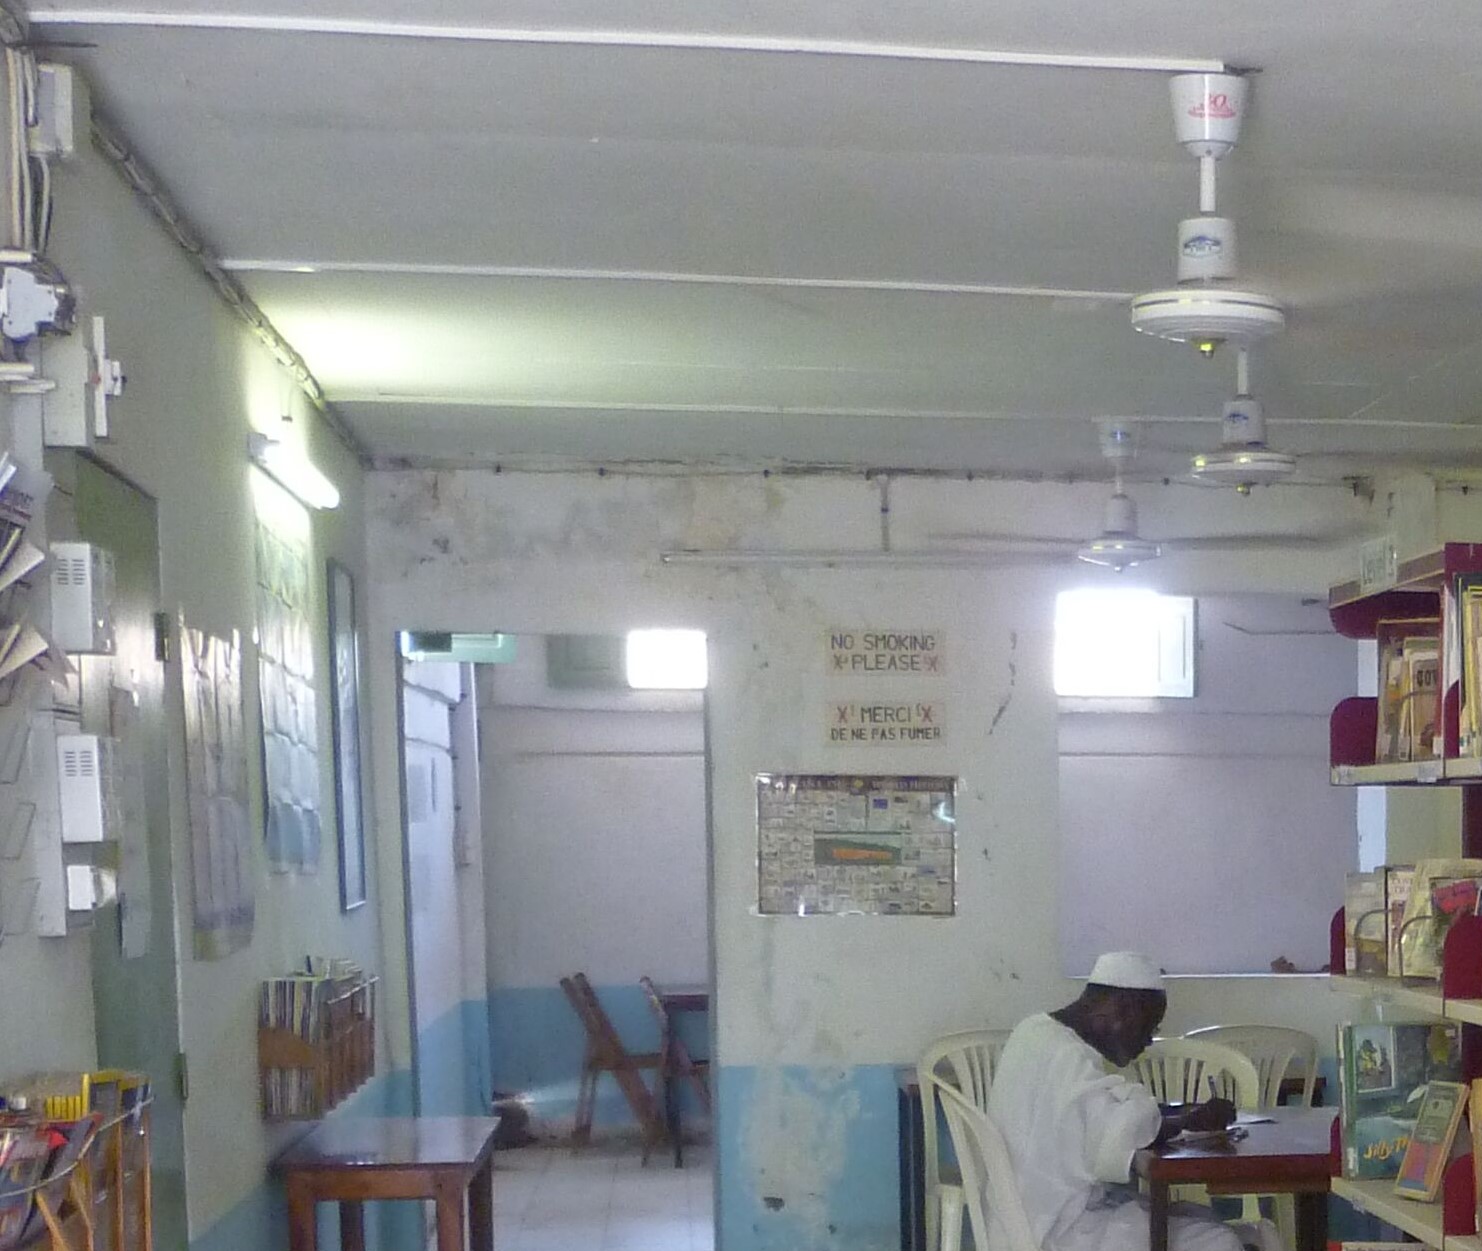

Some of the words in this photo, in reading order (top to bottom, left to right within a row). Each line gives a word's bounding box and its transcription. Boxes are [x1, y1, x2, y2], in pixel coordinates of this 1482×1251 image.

[831, 634, 854, 650] NO
[863, 634, 936, 651] SMOKING
[851, 655, 921, 671] PLEASE
[860, 706, 911, 723] MERCI
[831, 728, 848, 741] DE
[851, 728, 867, 741] NE
[871, 728, 896, 741] PAS
[900, 726, 941, 741] FUMER
